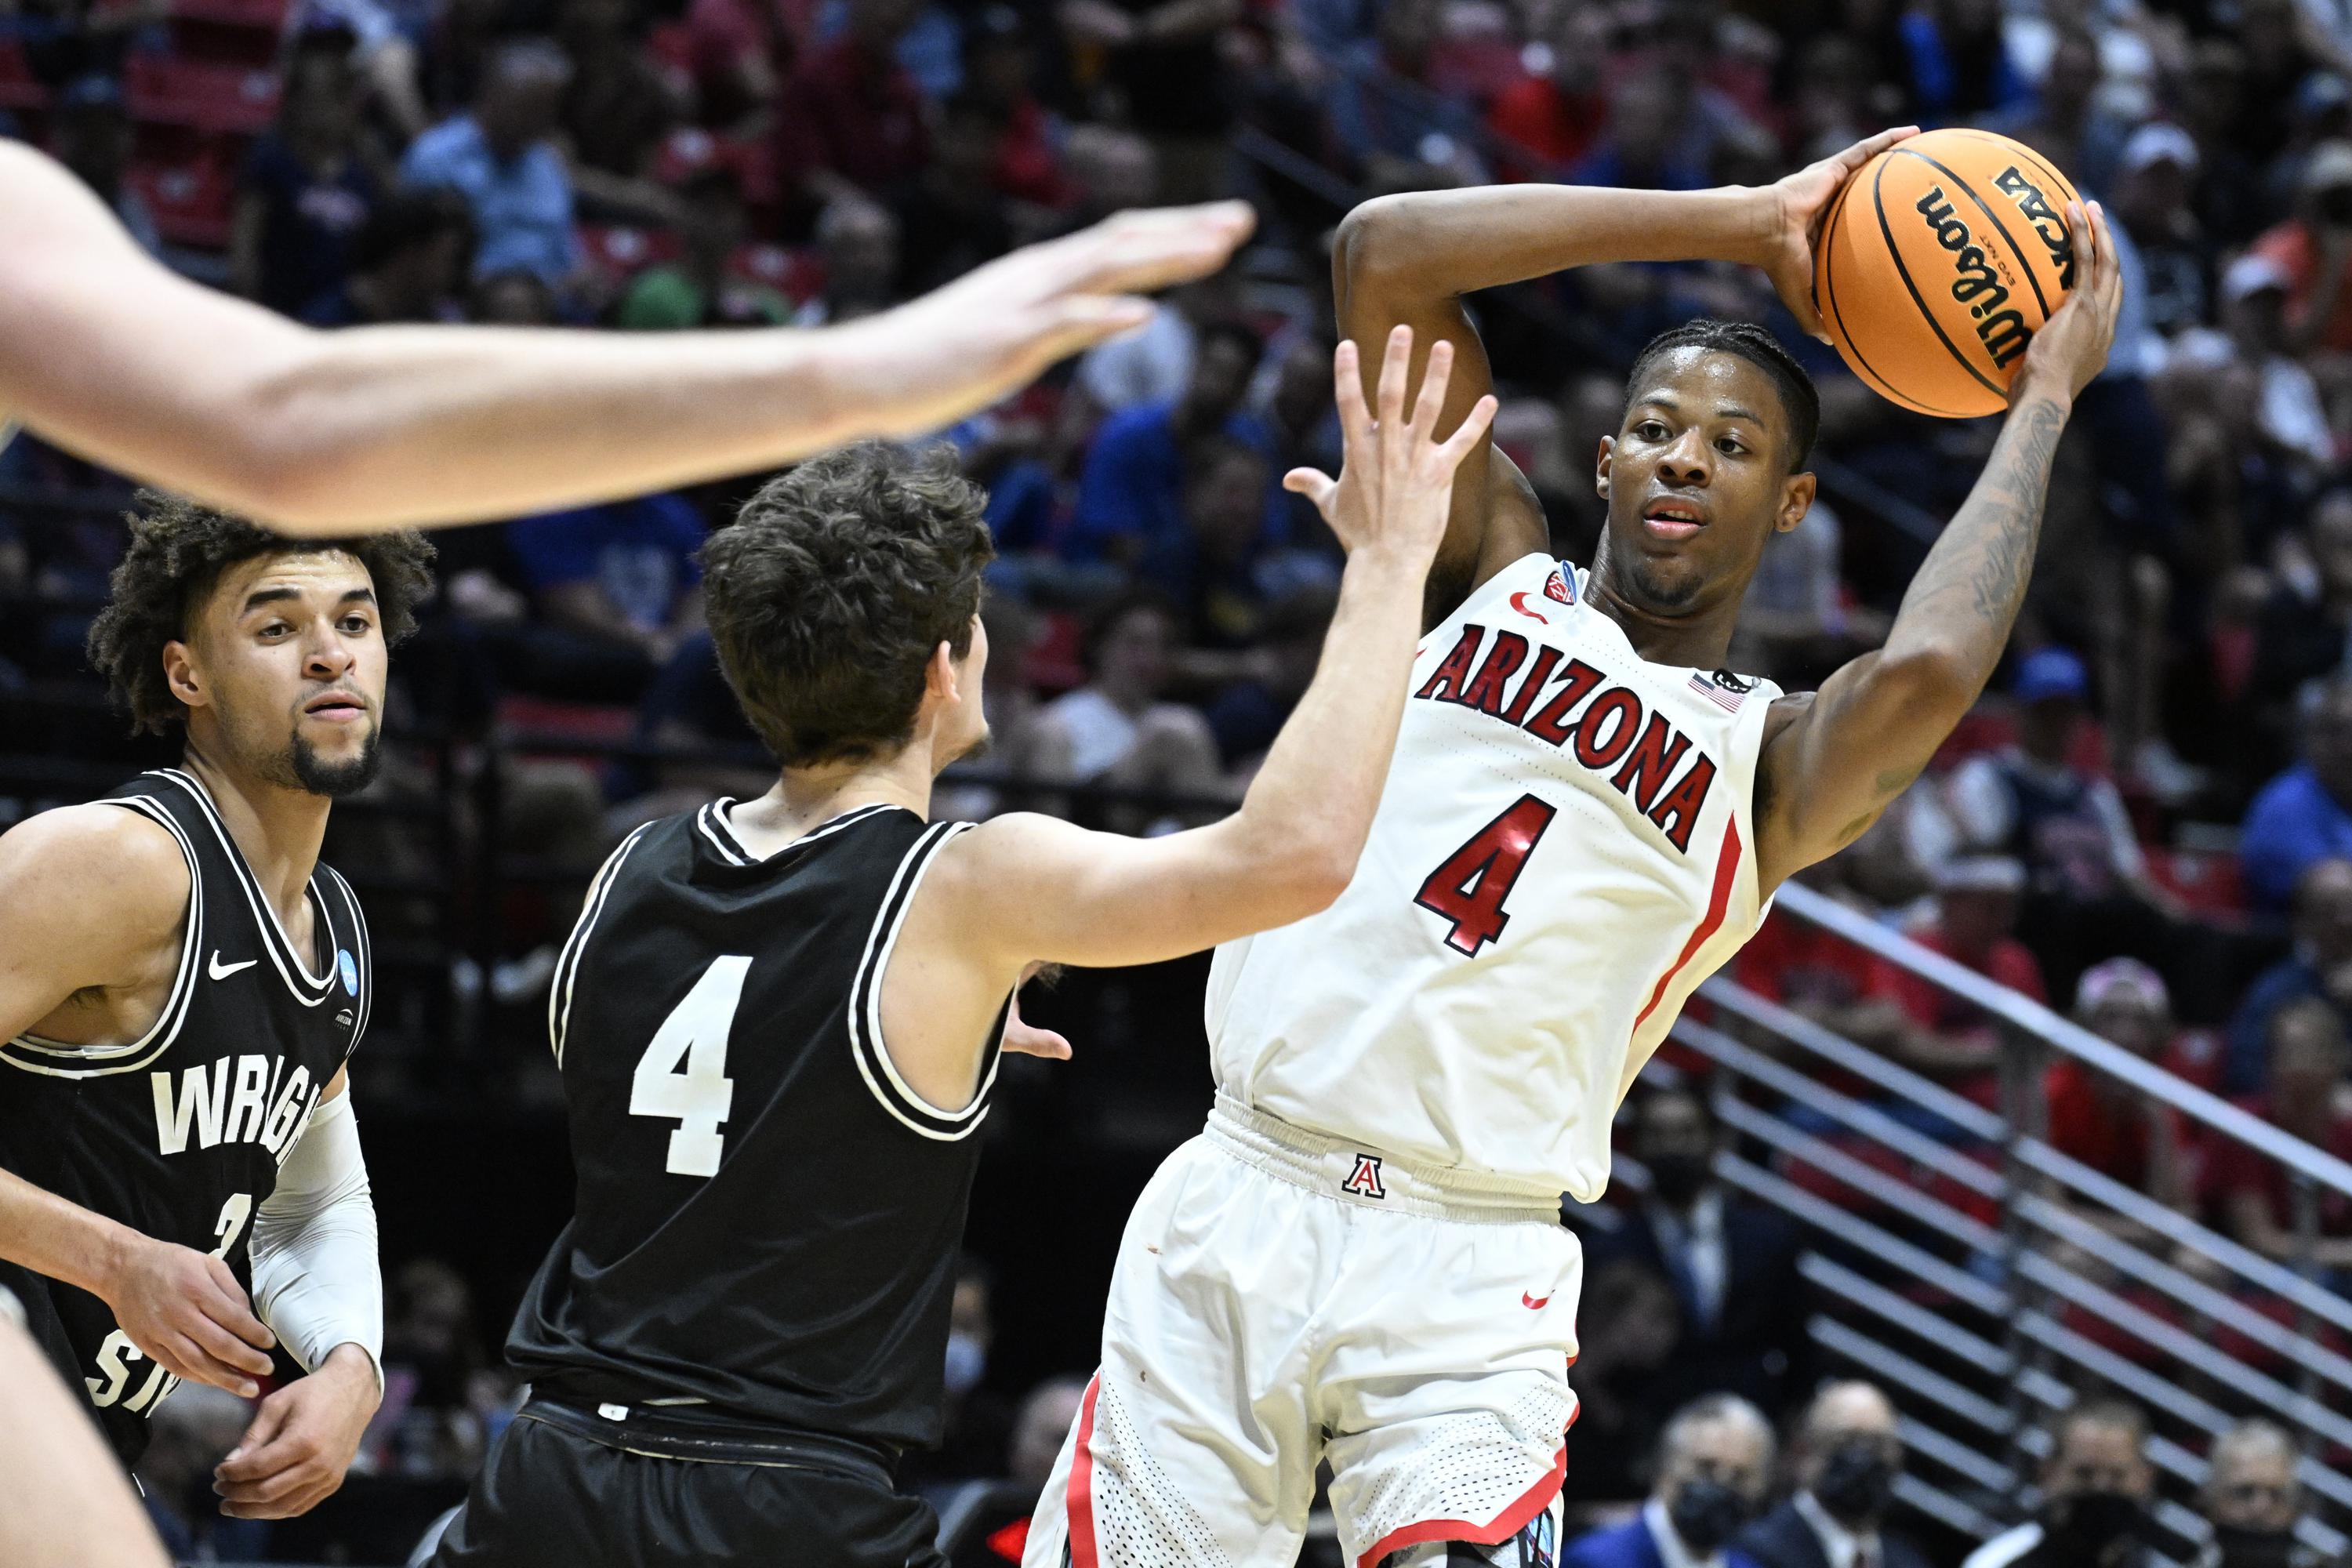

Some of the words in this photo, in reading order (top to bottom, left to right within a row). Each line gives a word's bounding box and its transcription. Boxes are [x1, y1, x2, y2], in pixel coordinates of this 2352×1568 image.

[1916, 183, 2033, 371] Wilson
[1414, 624, 1717, 855] ARIZONA
[1414, 793, 1557, 959] 4
[629, 954, 754, 1178] 4
[1341, 1152, 1386, 1200] A
